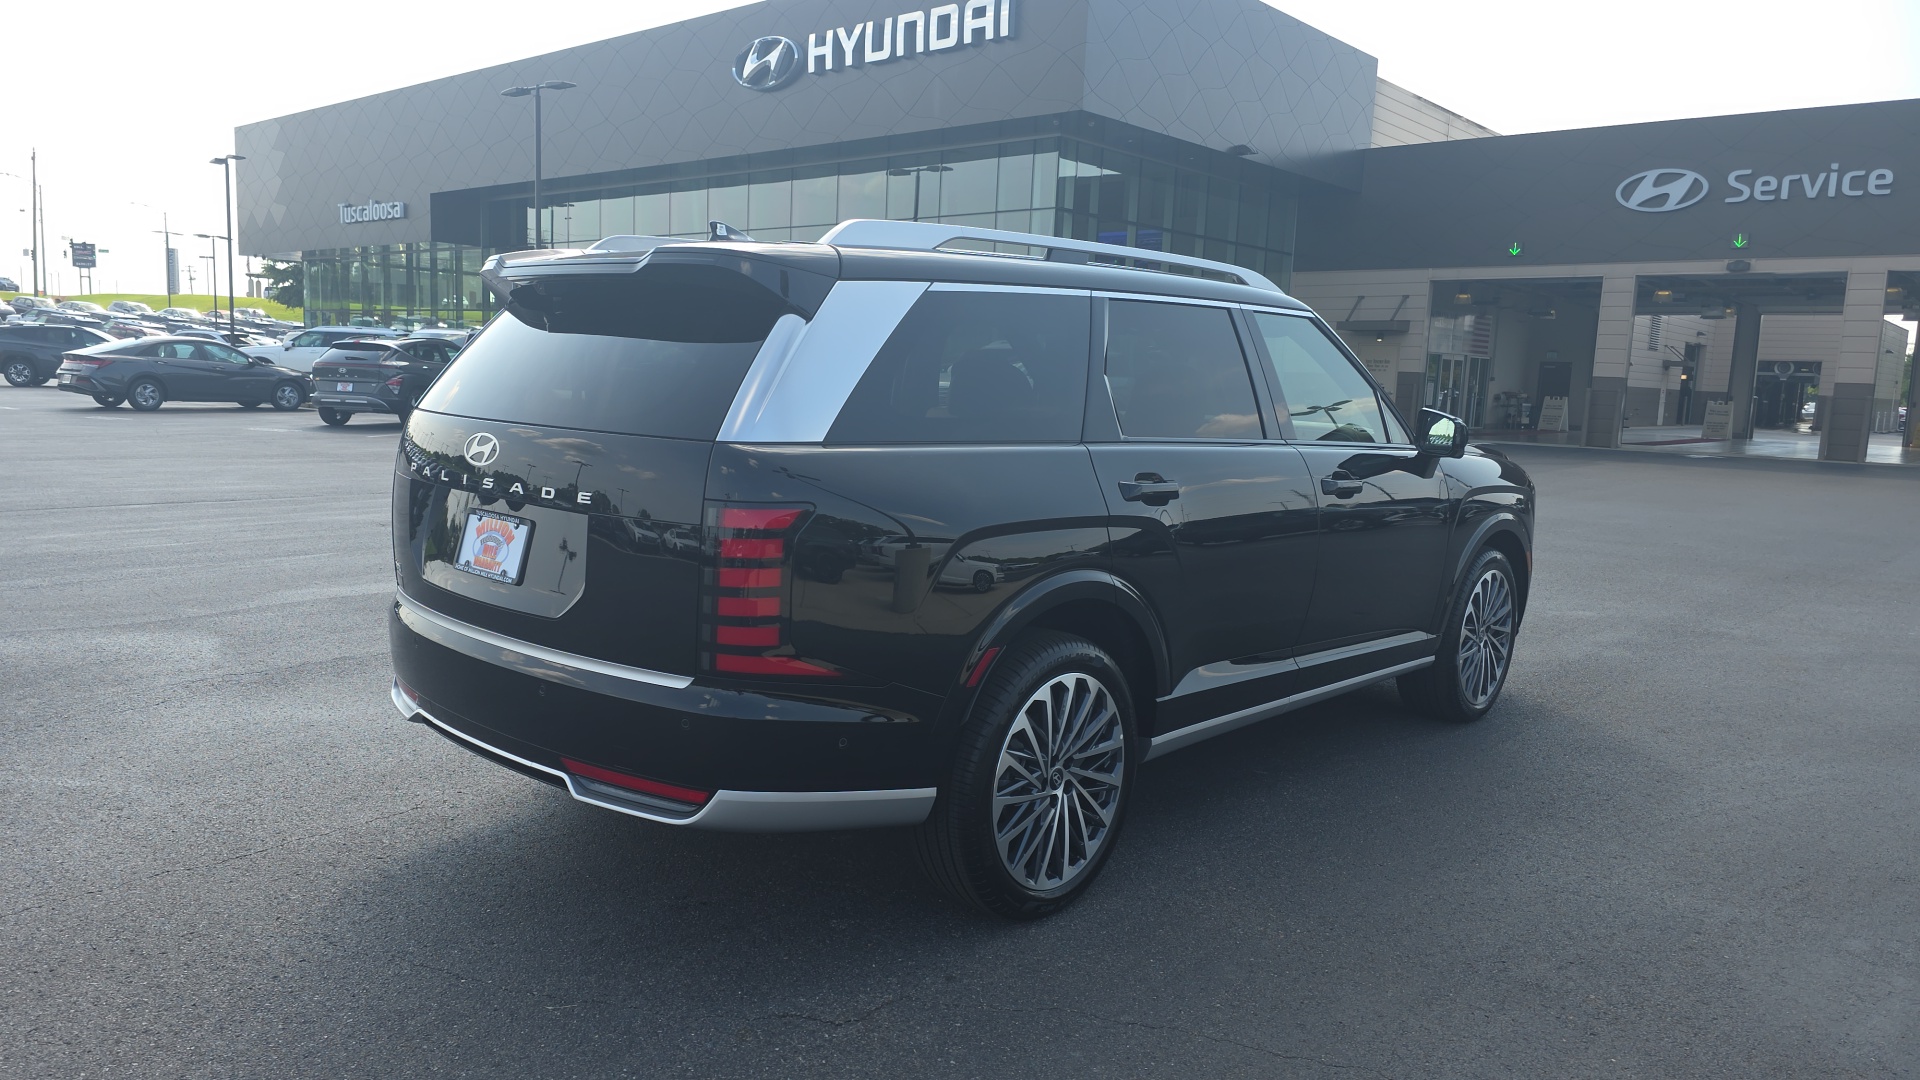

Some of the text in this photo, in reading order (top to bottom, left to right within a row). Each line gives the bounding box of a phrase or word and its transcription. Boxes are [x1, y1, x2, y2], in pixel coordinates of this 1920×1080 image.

[807, 0, 1010, 74] HYUNDAI
[1724, 162, 1894, 203] Service
[337, 199, 402, 224] Tuscaloosa
[410, 462, 593, 504] PALISADE
[475, 518, 516, 546] MILLION
